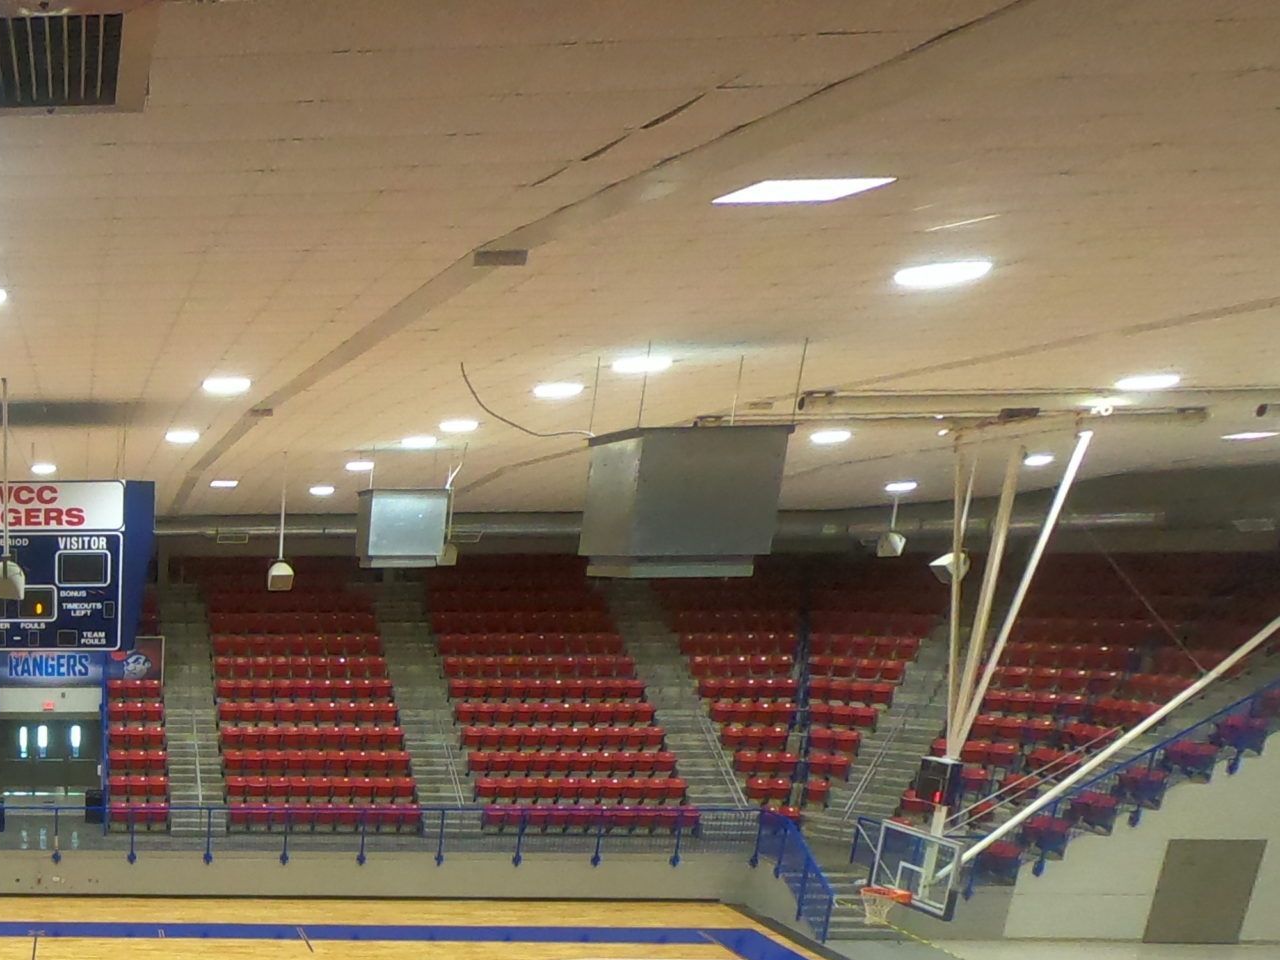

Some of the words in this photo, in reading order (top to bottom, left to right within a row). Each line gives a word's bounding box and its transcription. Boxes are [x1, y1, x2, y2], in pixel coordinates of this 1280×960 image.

[58, 536, 107, 550] VISITOR
[62, 602, 102, 610] TIMEOUTS
[8, 653, 90, 677] RANGERS
